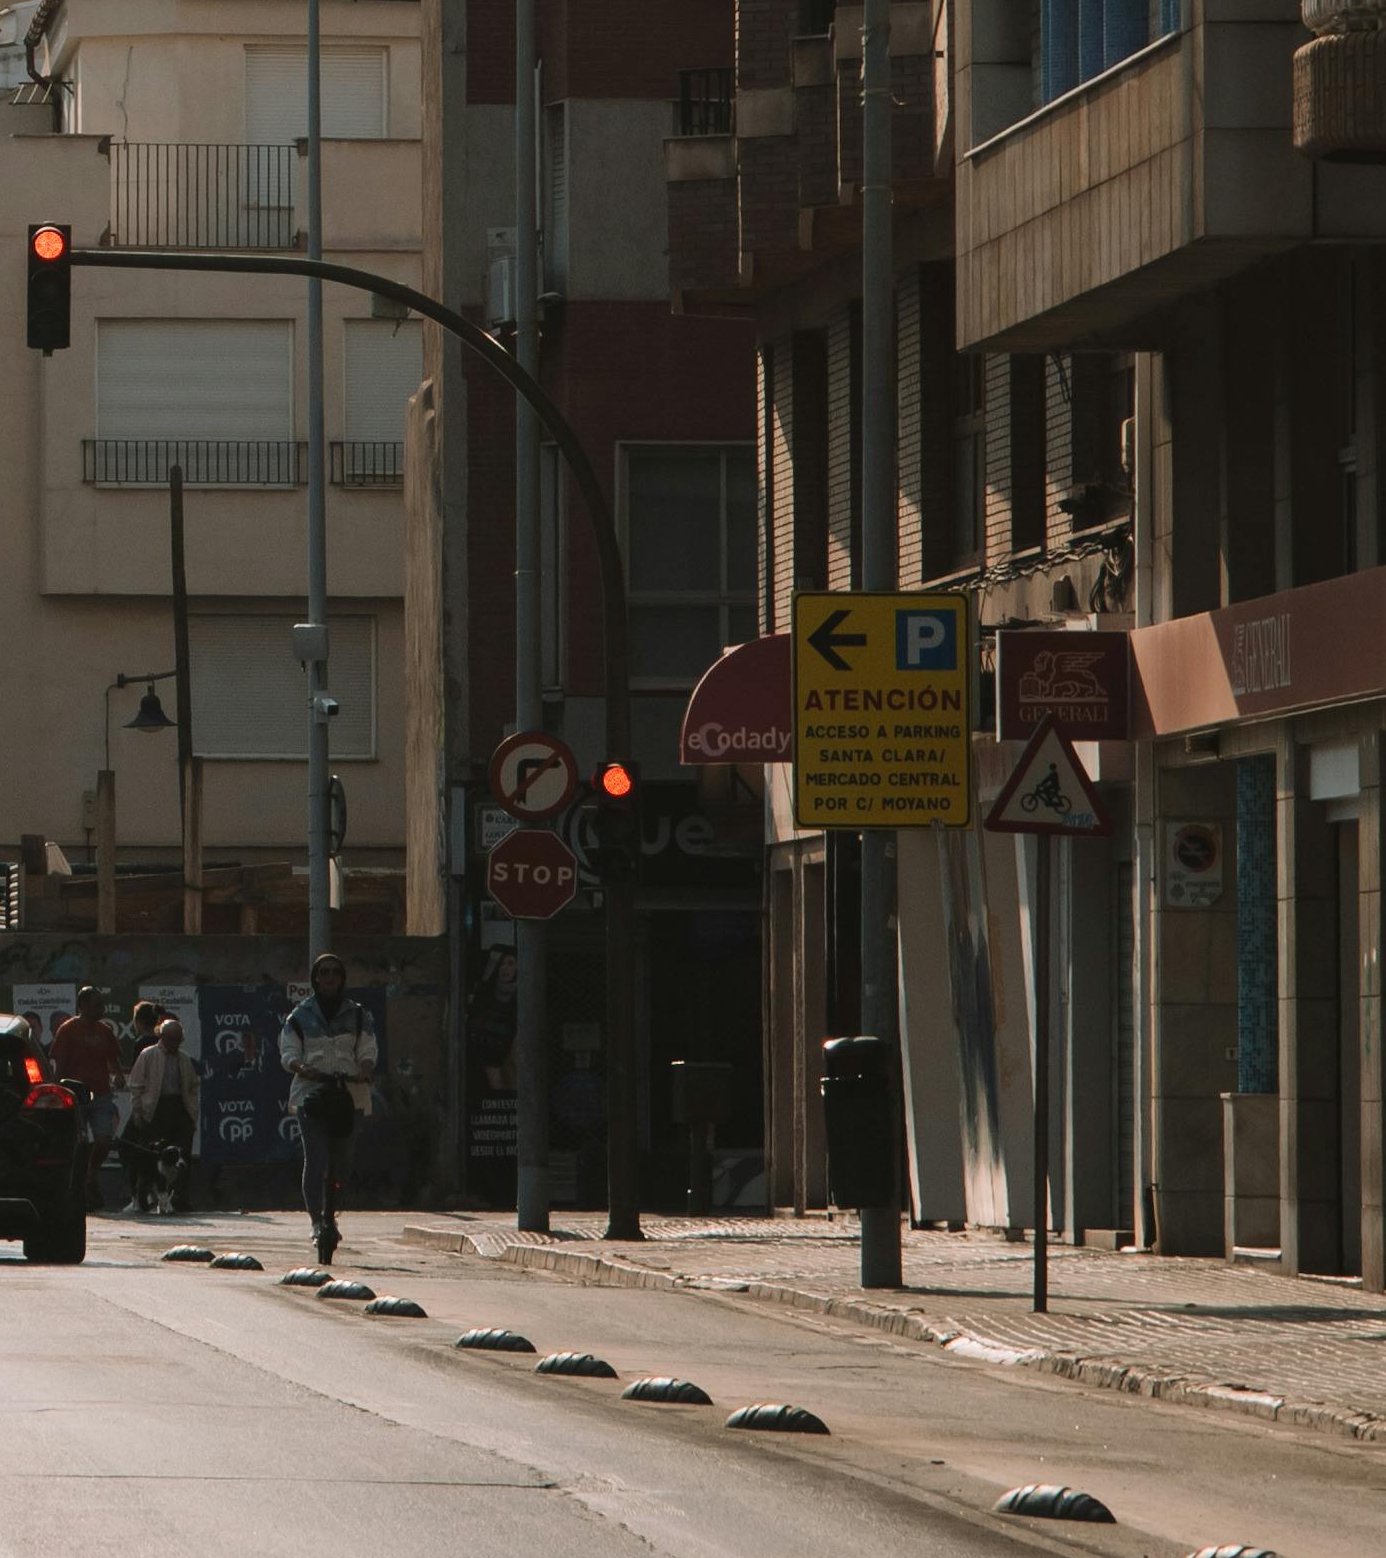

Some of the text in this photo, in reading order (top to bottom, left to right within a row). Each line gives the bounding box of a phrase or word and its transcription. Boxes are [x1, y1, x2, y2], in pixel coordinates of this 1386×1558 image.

[907, 616, 945, 665] P
[804, 685, 961, 711] ATENCIÓN
[805, 726, 961, 738] ACCESO A PARKING
[820, 749, 946, 762] SANTA CLARA/
[806, 773, 960, 786] MERCADO CENTRAL
[814, 797, 951, 812] POR C/ MOYANO
[492, 862, 574, 886] STOP
[214, 1013, 251, 1026] VOTA
[218, 1100, 255, 1113] VOTA
